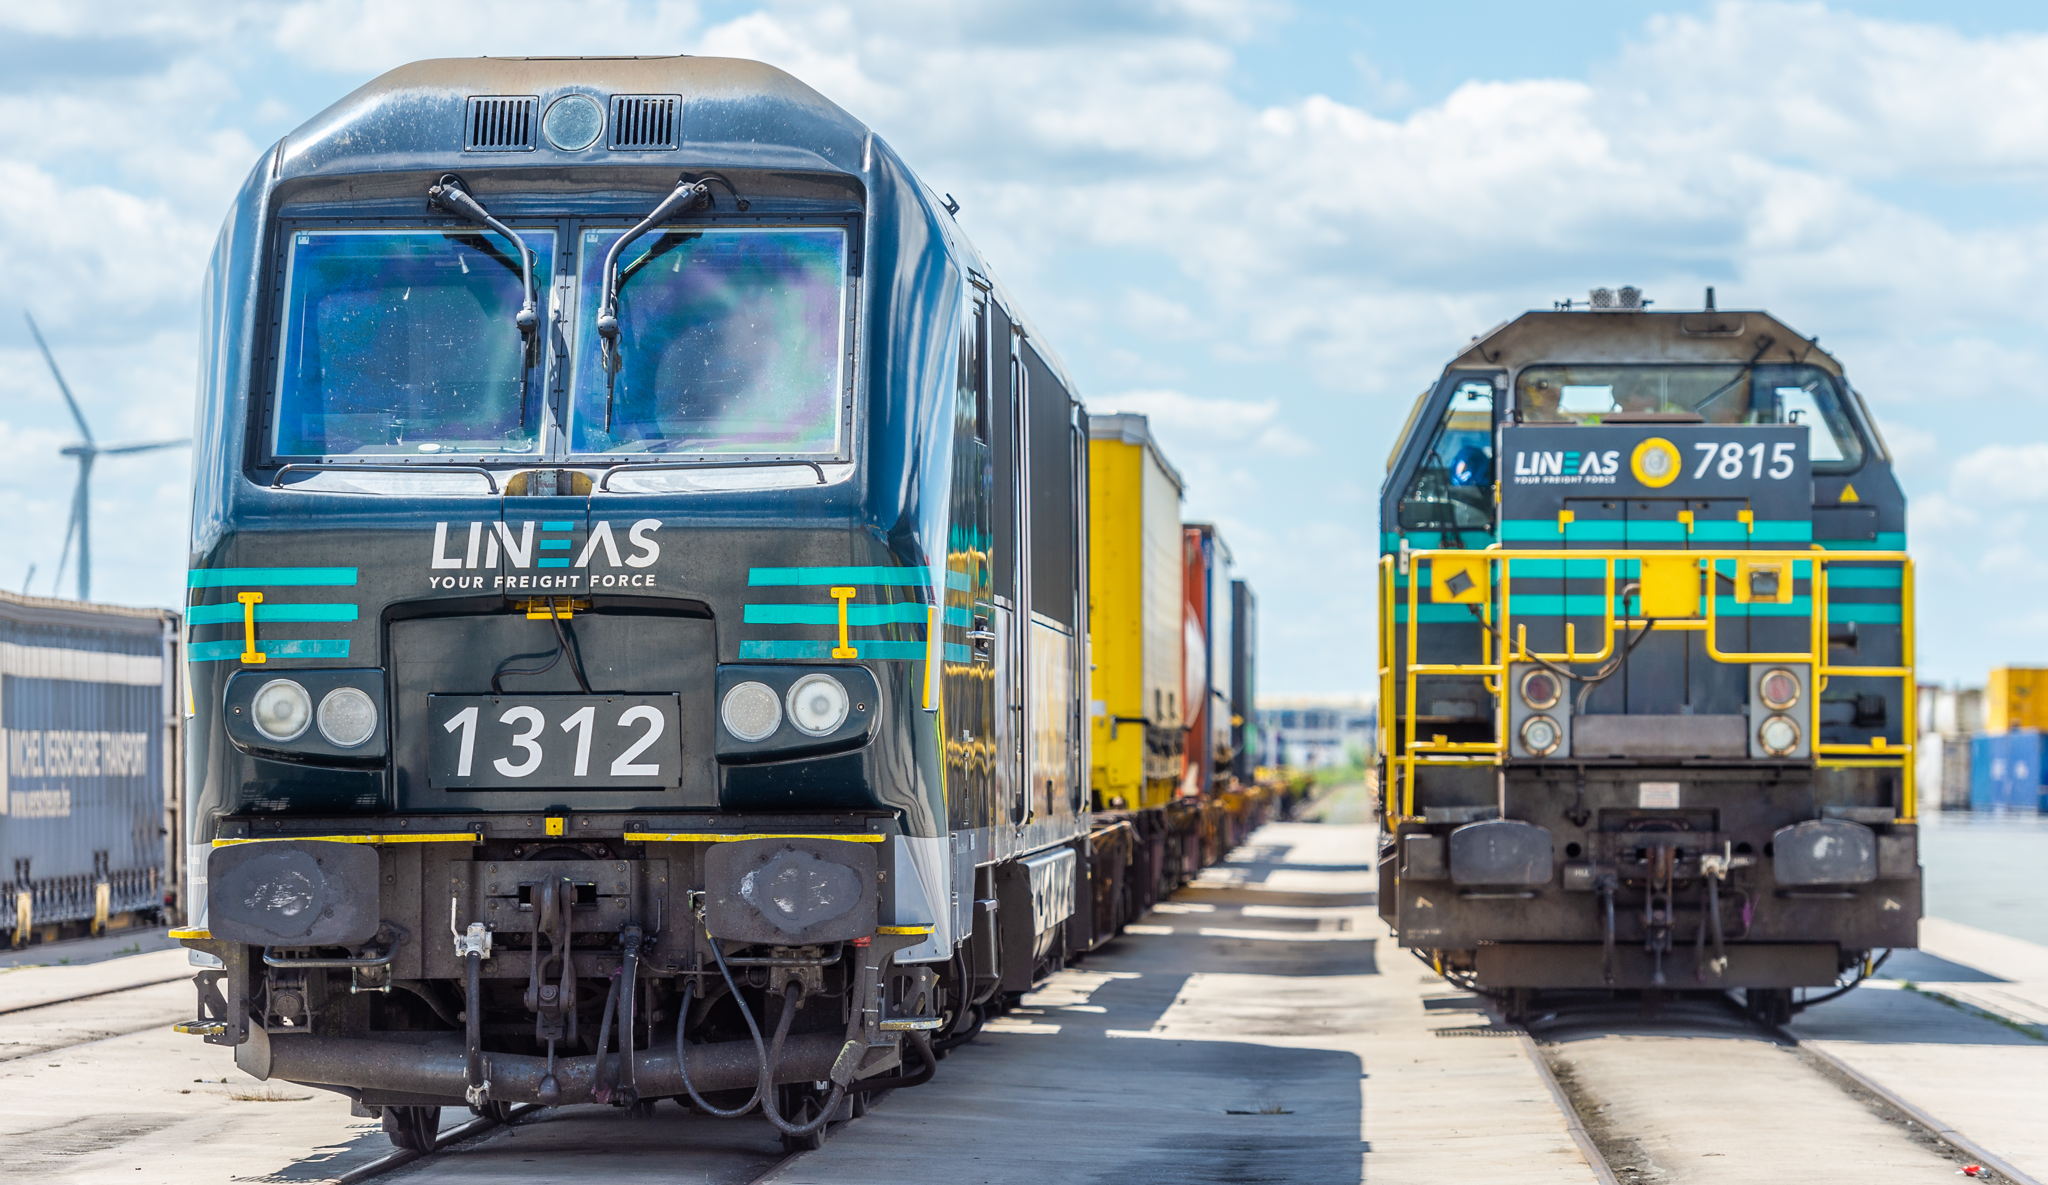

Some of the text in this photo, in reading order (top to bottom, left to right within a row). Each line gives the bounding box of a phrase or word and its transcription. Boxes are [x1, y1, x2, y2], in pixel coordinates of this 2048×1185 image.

[1514, 450, 1620, 475] LINEAS
[1514, 474, 1616, 484] YOUR FREIGHT FORCE
[1693, 442, 1796, 480] 7815
[431, 518, 663, 569] LINEAS
[429, 574, 656, 589] YOUR FREIGHT FORCE
[101, 731, 148, 777] TRANSPORT
[443, 705, 665, 777] 1312
